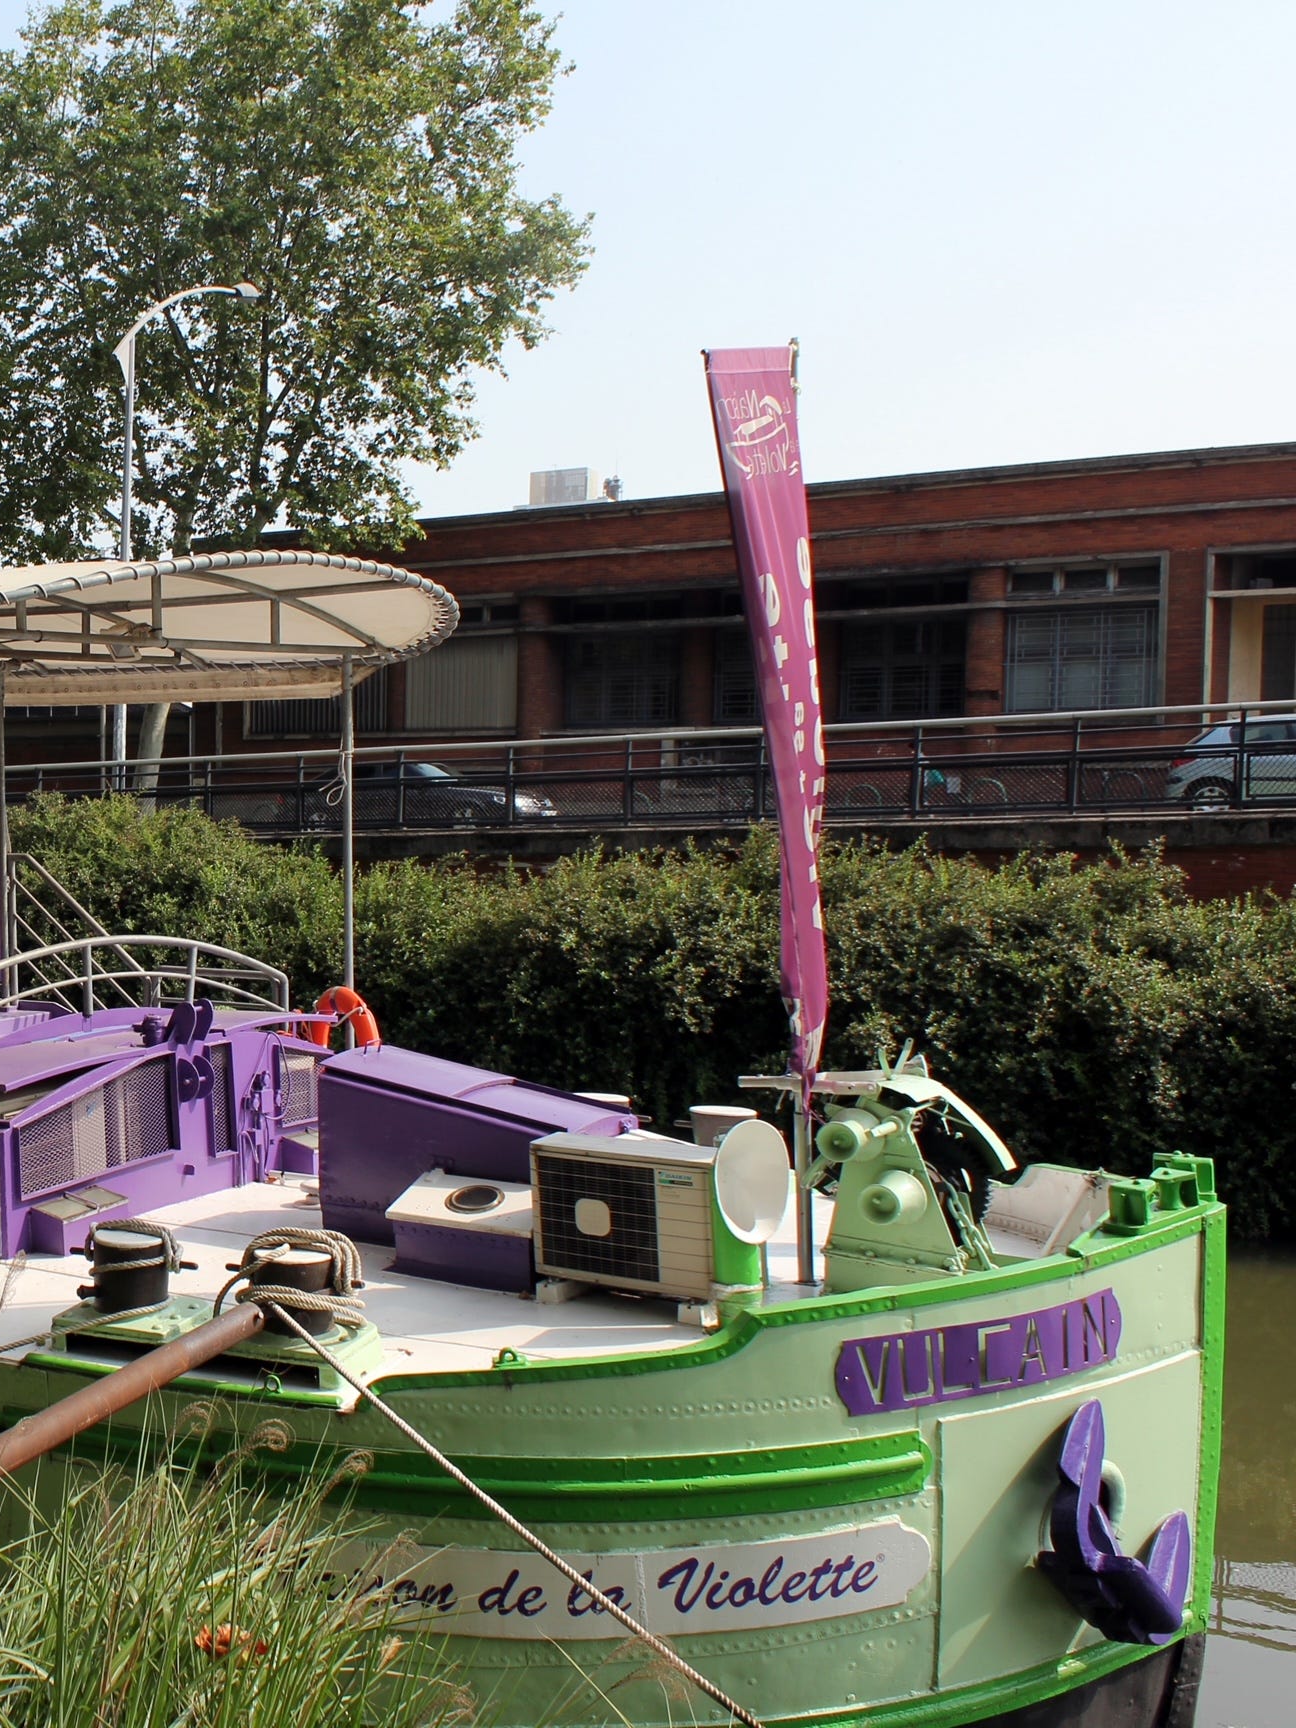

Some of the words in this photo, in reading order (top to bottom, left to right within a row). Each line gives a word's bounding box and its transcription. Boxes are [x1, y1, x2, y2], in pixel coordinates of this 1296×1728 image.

[855, 1295, 1109, 1405] VULCAIN
[478, 1569, 548, 1617] de
[567, 1568, 633, 1617] la
